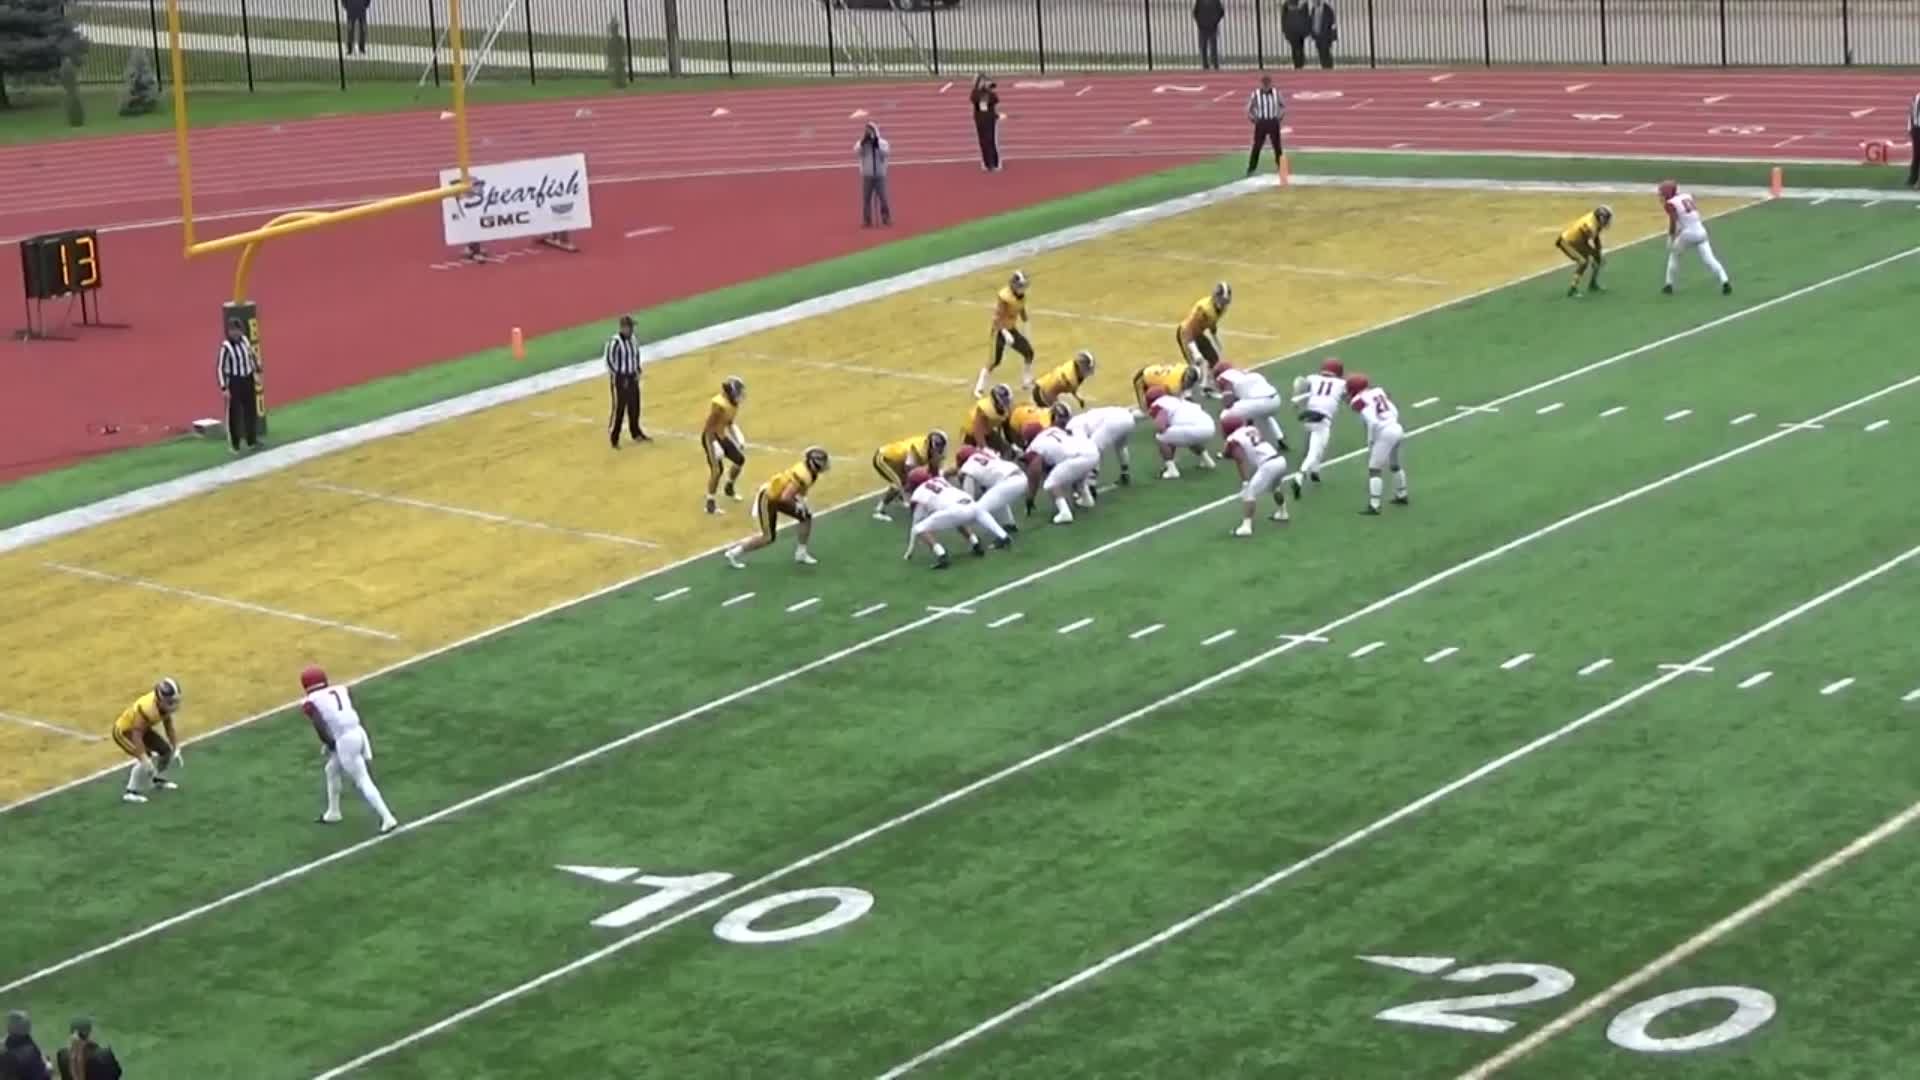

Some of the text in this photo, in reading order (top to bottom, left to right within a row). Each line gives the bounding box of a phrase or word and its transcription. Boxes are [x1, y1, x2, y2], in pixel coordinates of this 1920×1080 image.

[457, 169, 579, 215] Spearfish
[480, 211, 530, 228] GMC
[60, 236, 98, 286] 13
[1317, 380, 1334, 397] 11
[328, 690, 343, 711] 7
[589, 871, 874, 943] 10
[1374, 962, 1777, 1051] 20
